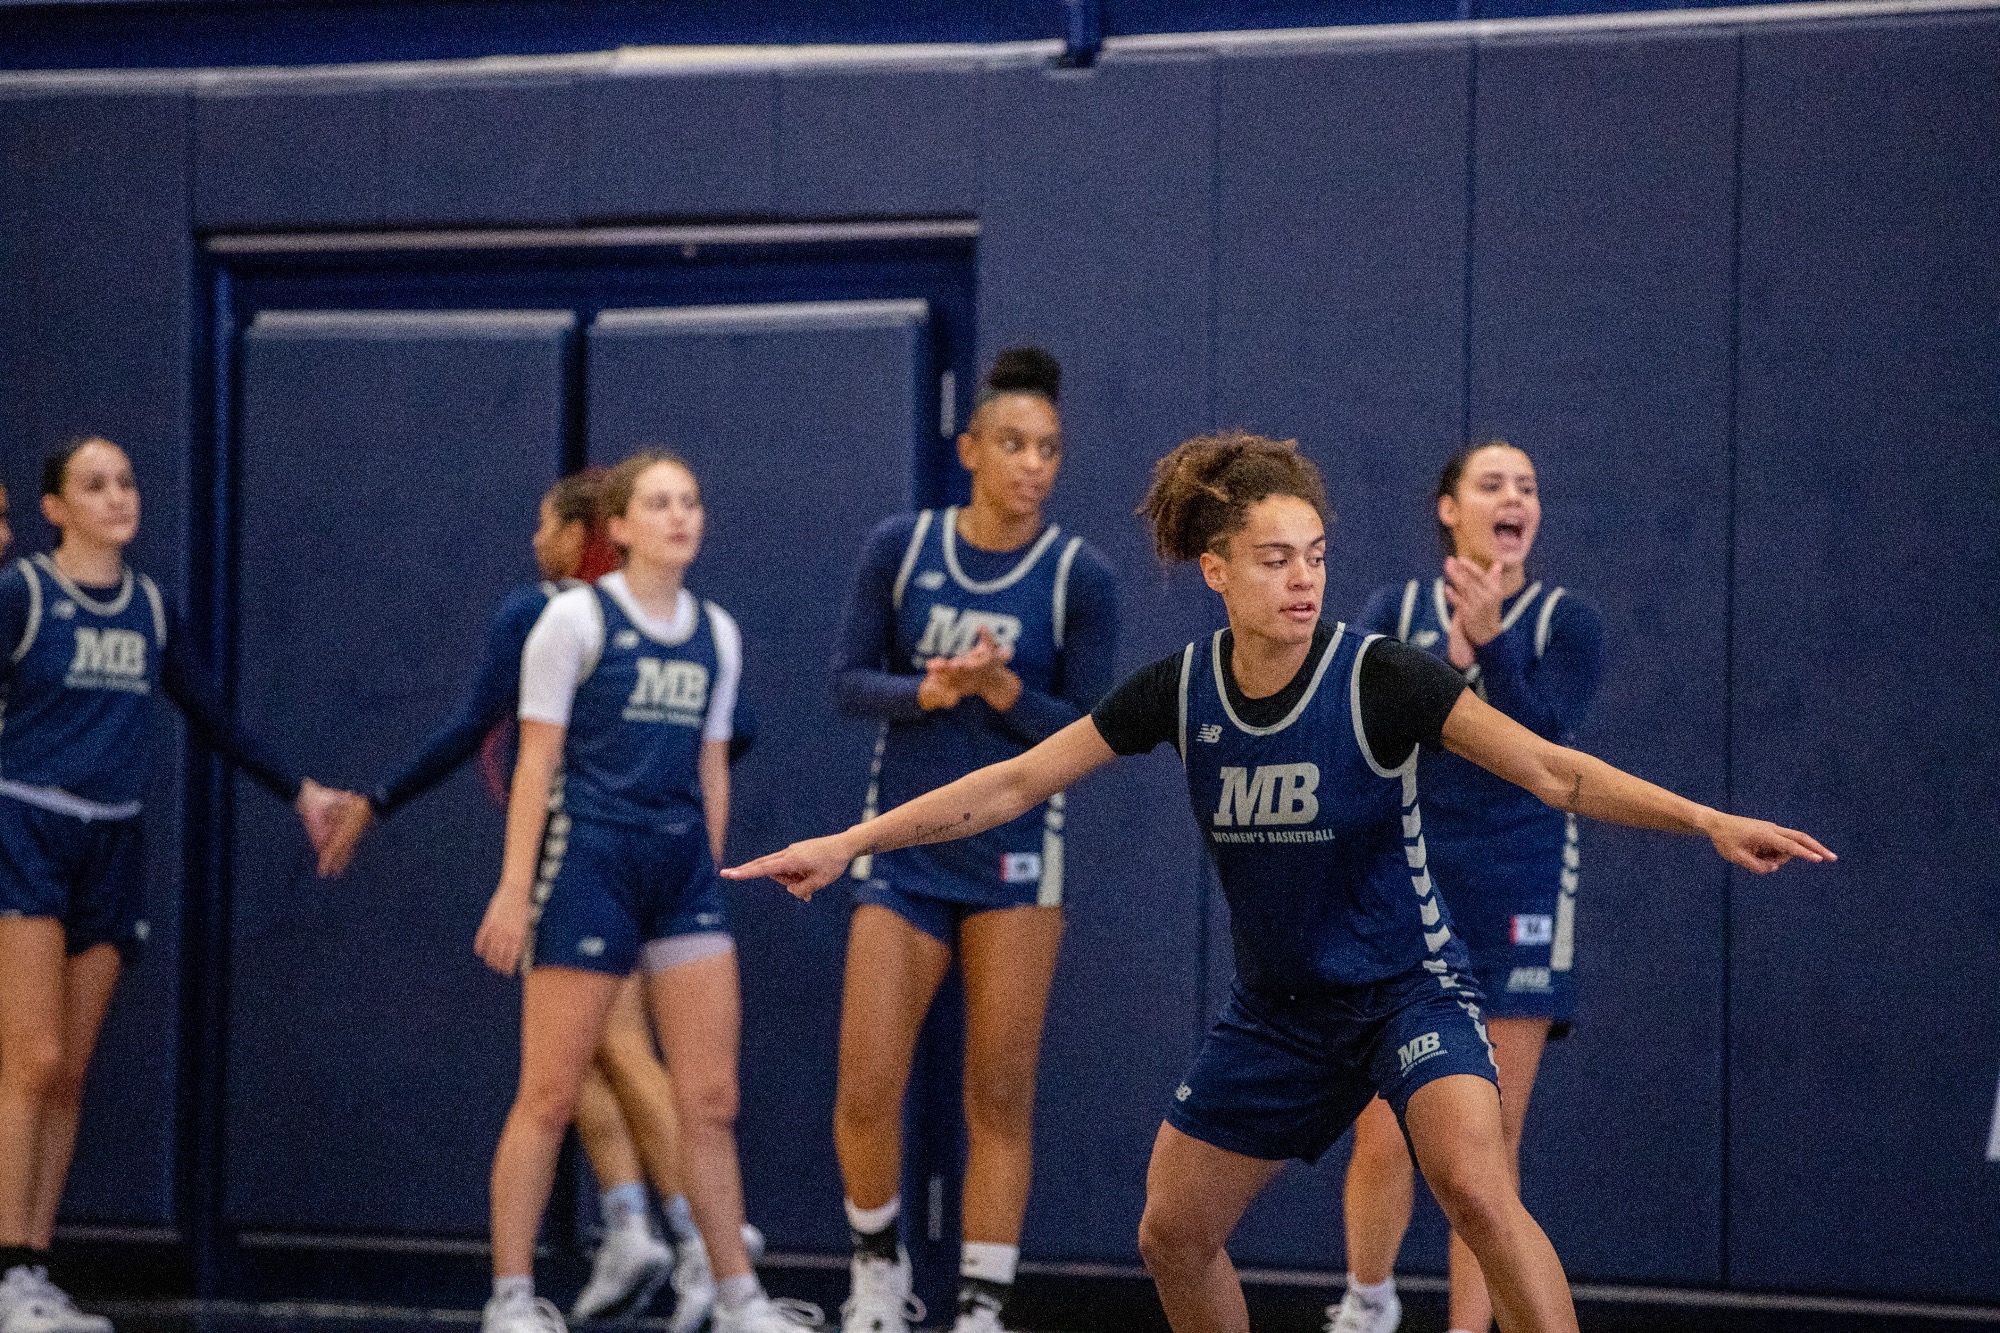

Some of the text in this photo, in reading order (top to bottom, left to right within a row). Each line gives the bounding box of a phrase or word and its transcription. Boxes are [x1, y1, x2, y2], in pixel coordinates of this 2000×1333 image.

[68, 626, 147, 678] MB
[628, 656, 709, 710] MB
[1213, 762, 1320, 826] MB
[1212, 828, 1336, 844] WOMEN'S BASKETBALL
[1397, 1031, 1441, 1070] MB
